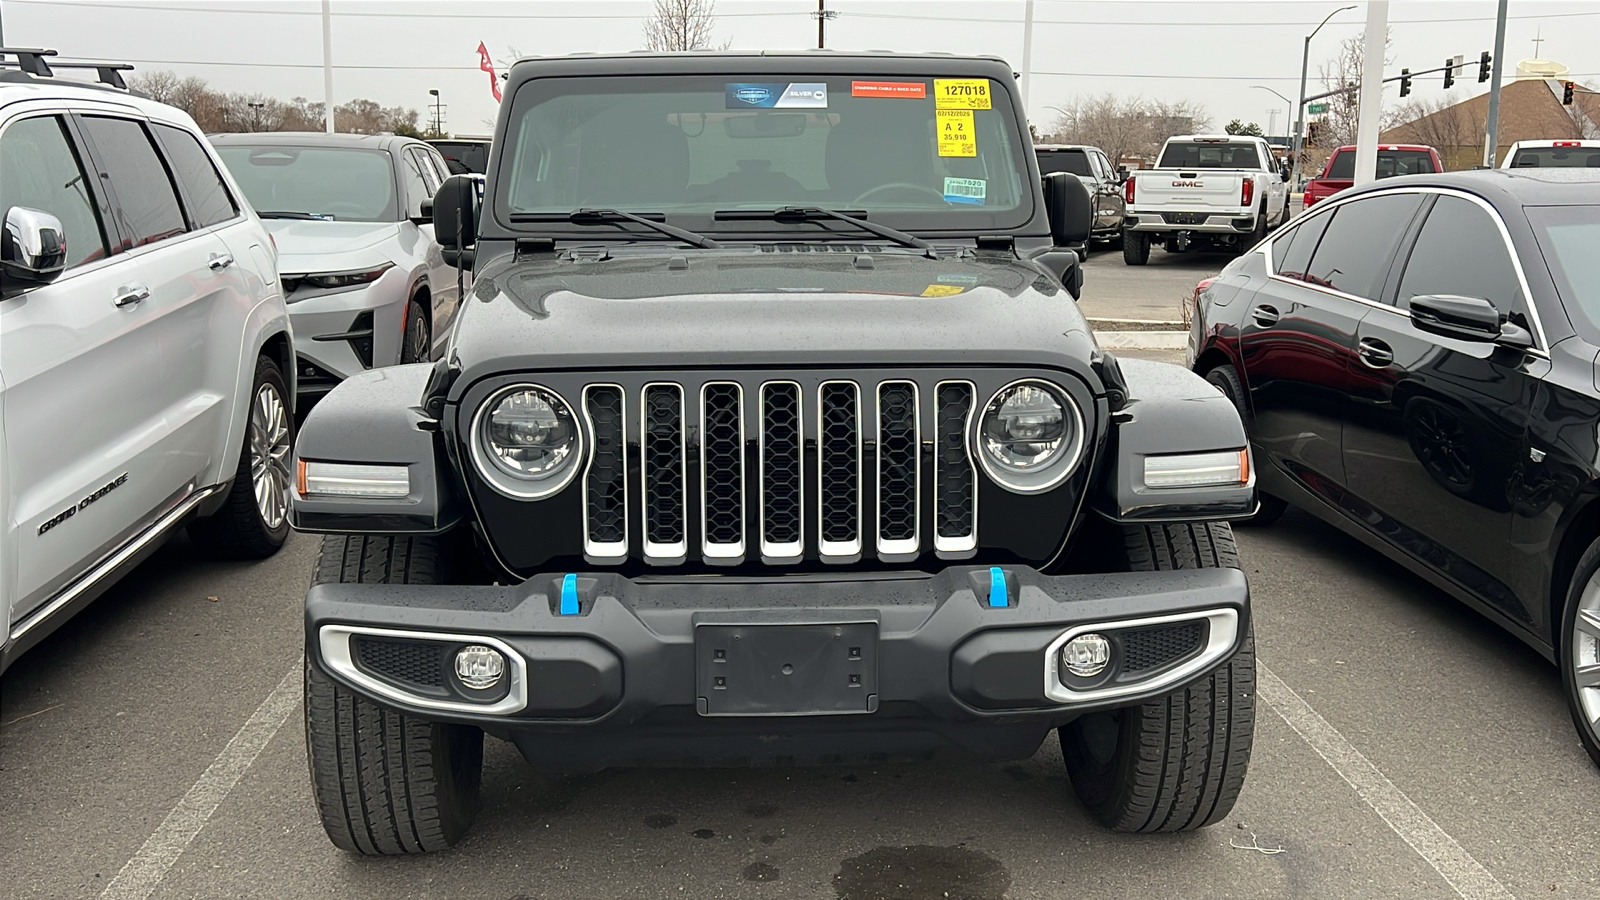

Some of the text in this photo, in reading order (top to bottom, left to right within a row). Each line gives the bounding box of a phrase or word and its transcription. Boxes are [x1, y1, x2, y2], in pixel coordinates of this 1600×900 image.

[944, 85, 986, 96] 127018
[945, 123, 963, 131] A 2
[38, 471, 128, 536] GRAND CHEROKEE
